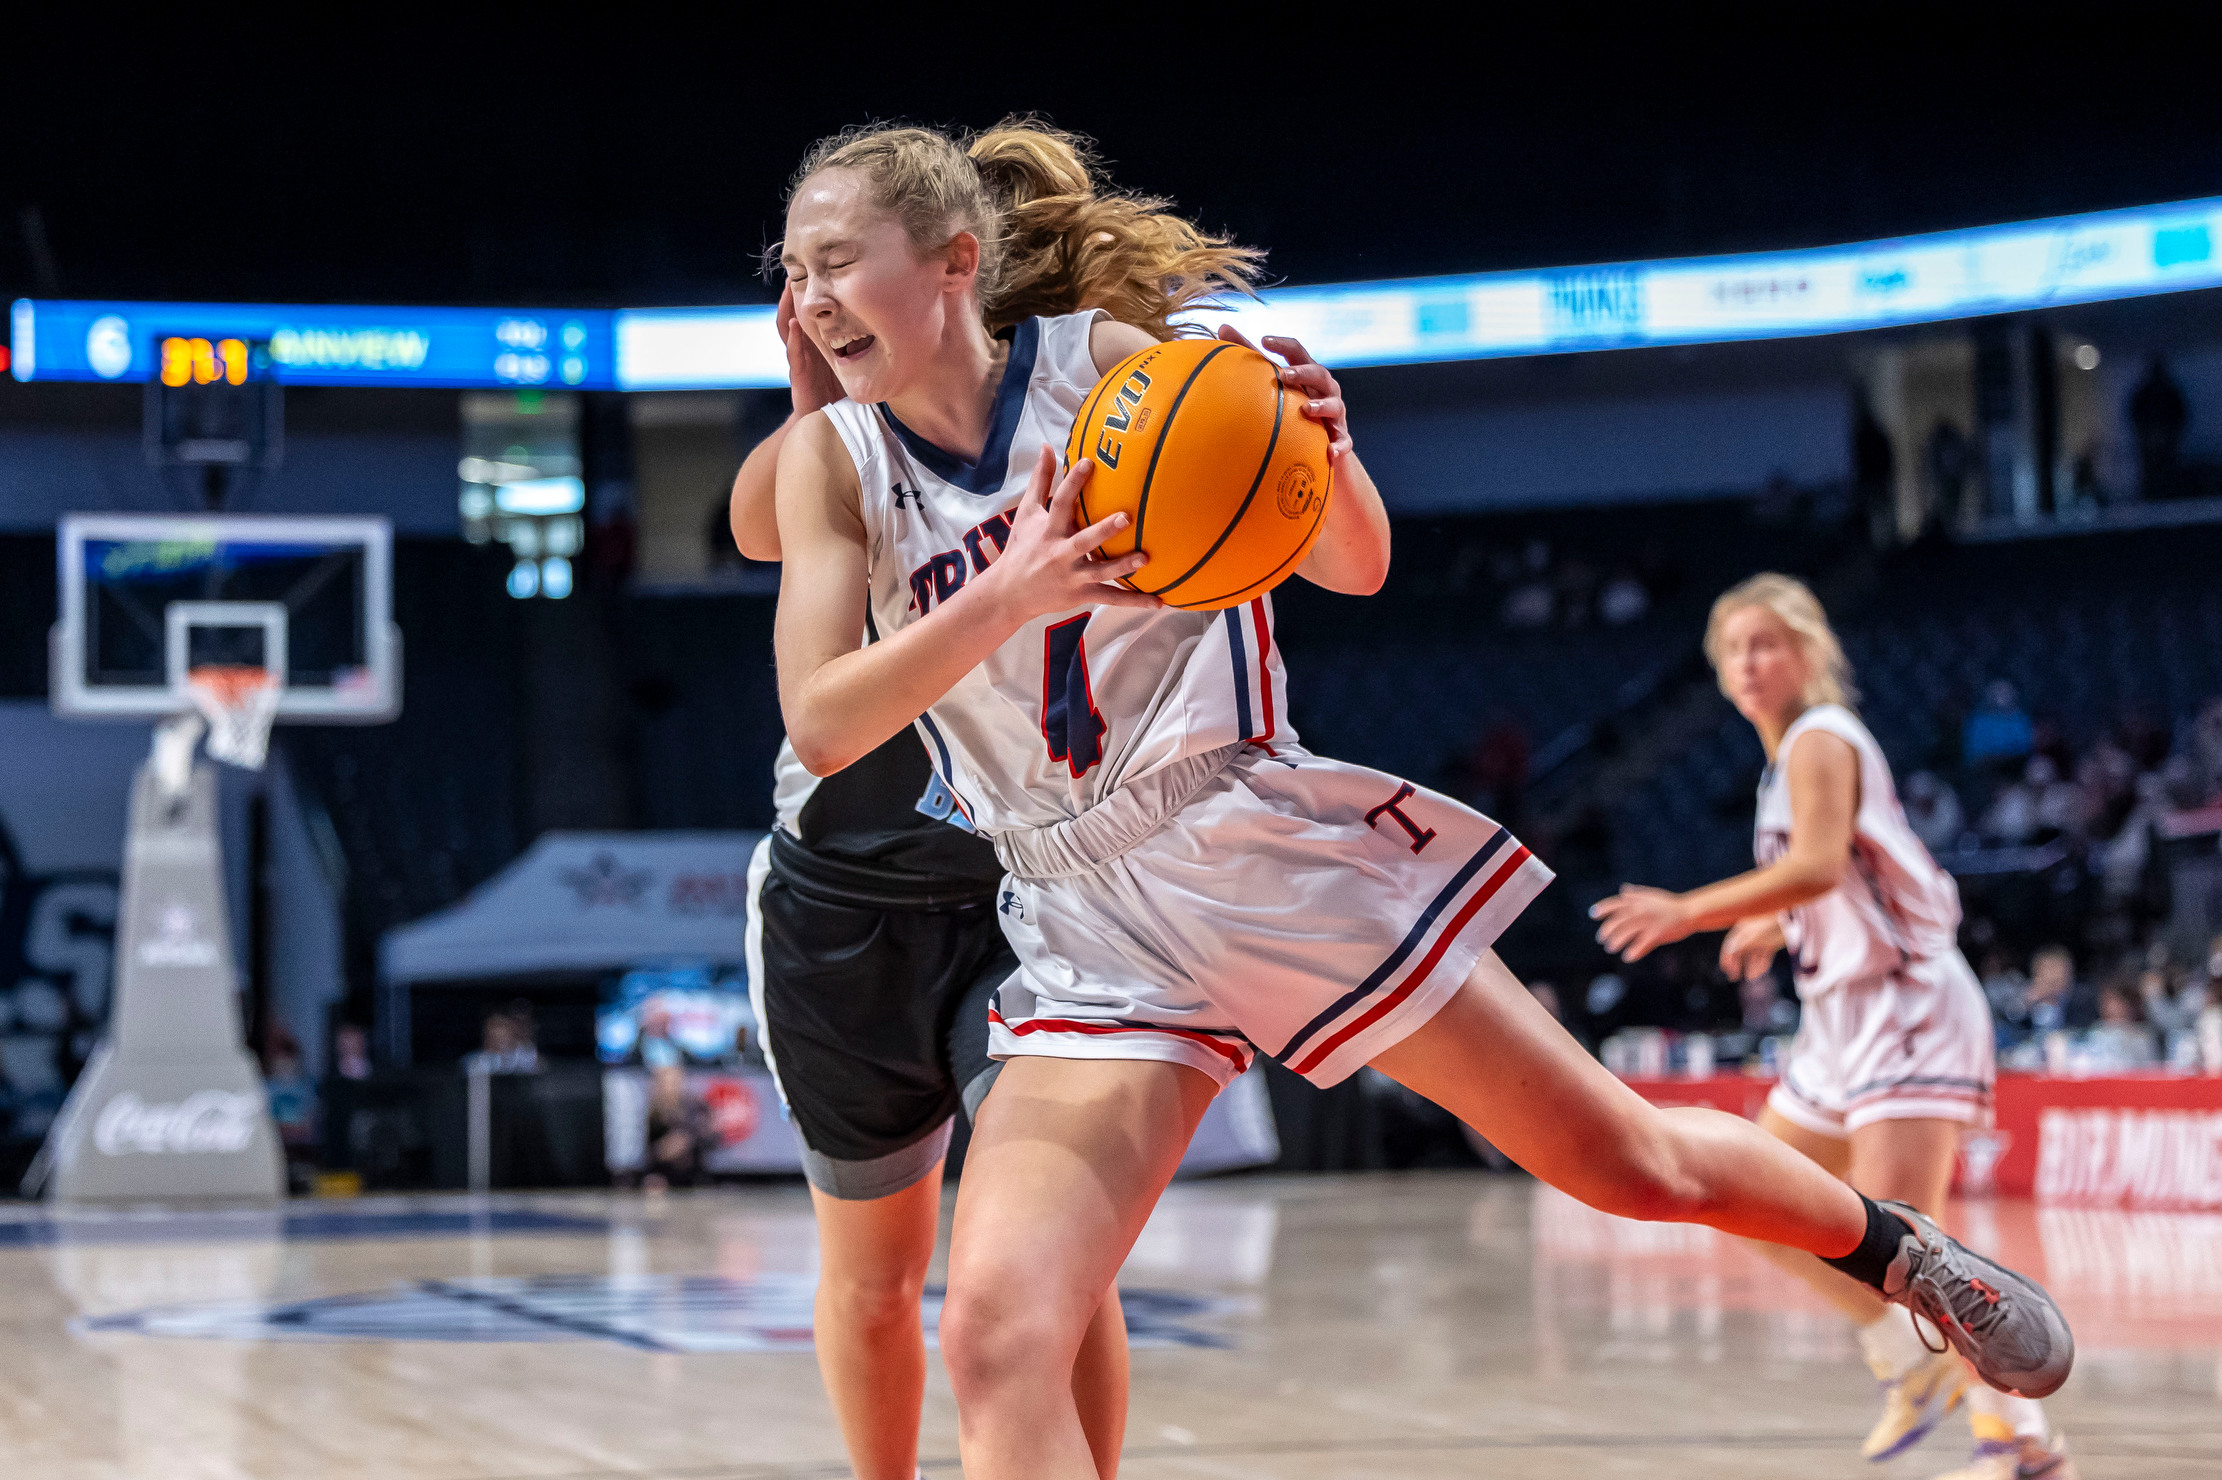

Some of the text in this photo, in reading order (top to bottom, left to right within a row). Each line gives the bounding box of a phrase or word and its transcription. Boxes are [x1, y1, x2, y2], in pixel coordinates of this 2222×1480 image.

[1096, 368, 1153, 472] EVO
[1138, 350, 1162, 369] NXT
[909, 497, 1053, 617] TRIN
[1040, 611, 1107, 779] 4
[1363, 781, 1437, 855] T
